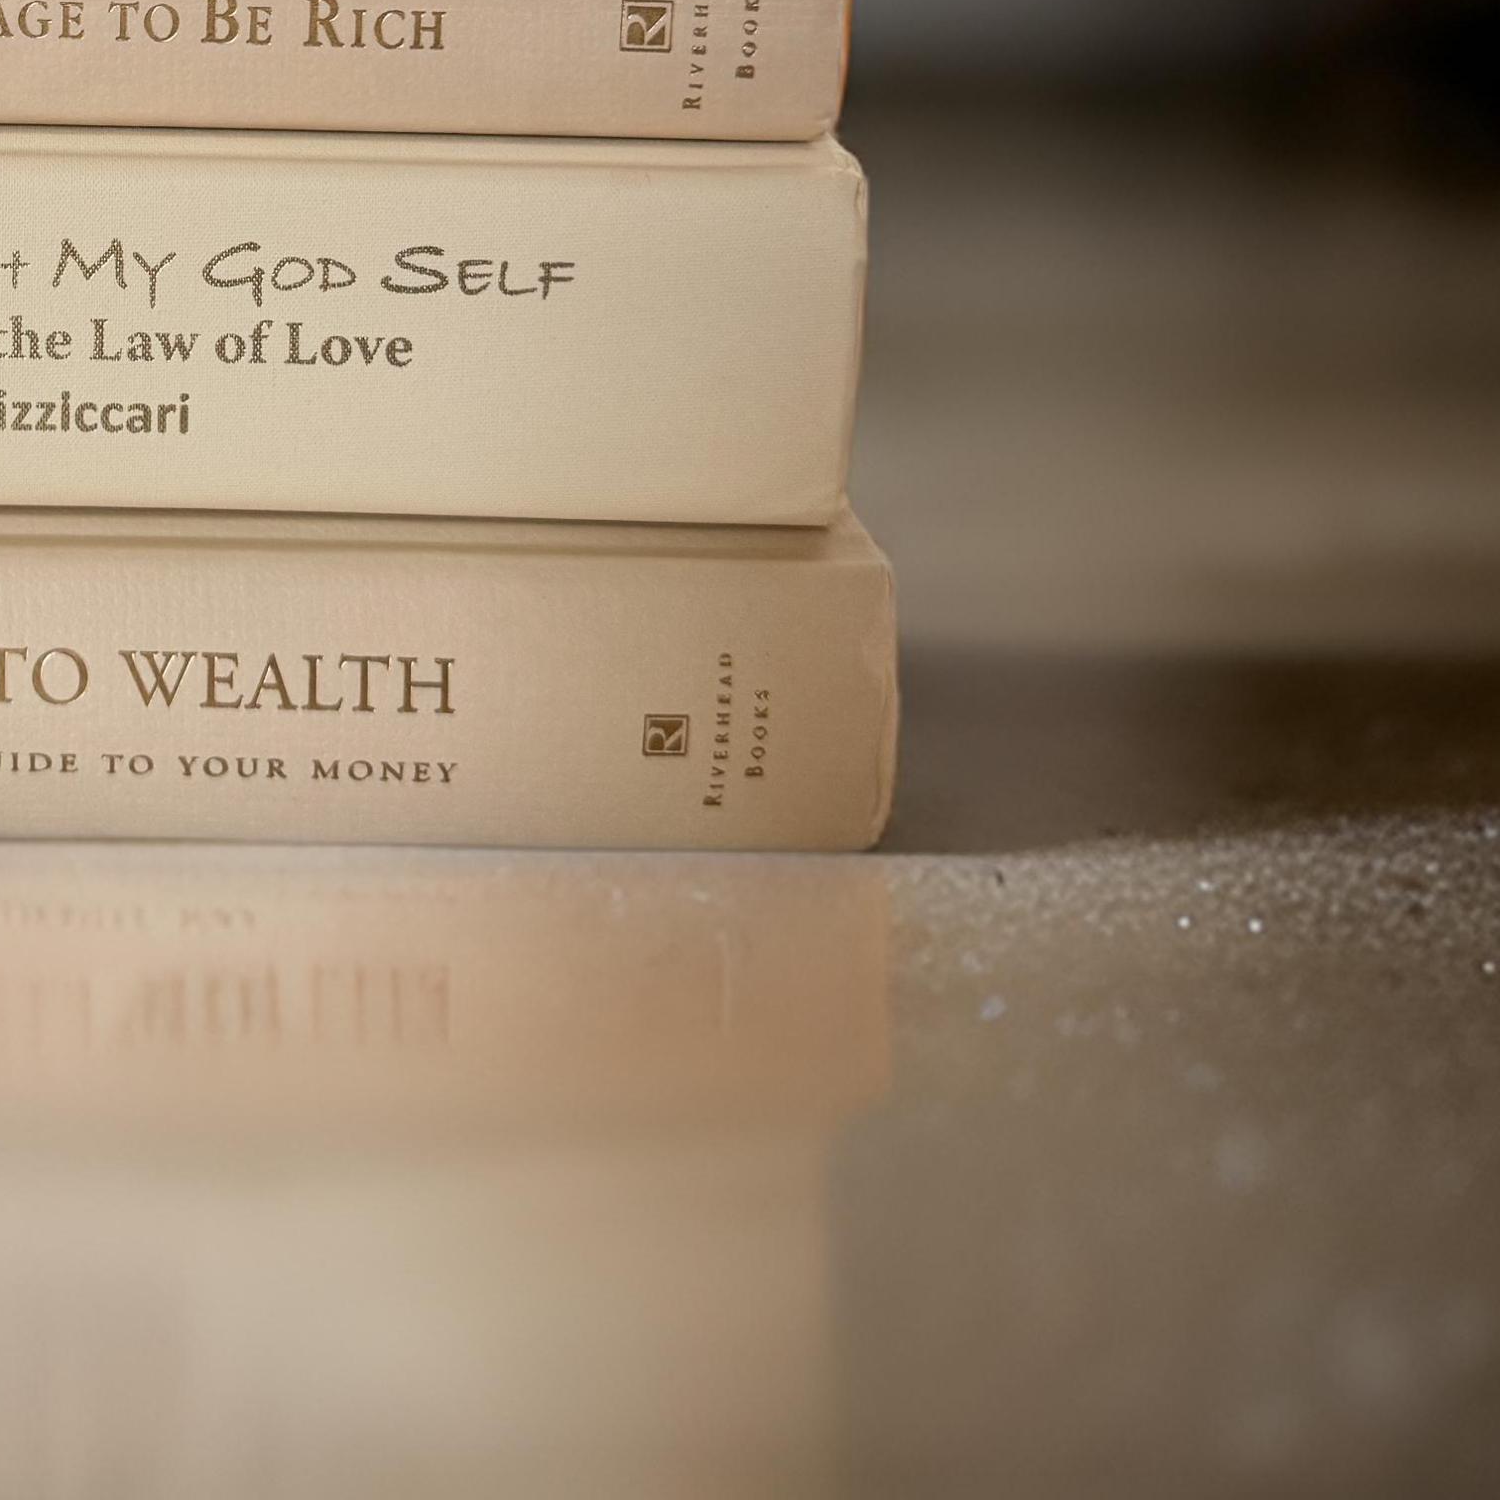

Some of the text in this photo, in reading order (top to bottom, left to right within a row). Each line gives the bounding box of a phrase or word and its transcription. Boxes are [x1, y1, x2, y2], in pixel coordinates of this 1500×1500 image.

[108, 0, 181, 44] TO
[52, 238, 177, 309] MY
[202, 241, 357, 307] GOD
[380, 245, 576, 299] SELF
[89, 318, 200, 363] Law
[214, 319, 274, 365] of
[284, 321, 414, 368] Love
[118, 649, 457, 715] WEALTH
[703, 652, 733, 806] RIVERHEAD
[744, 689, 770, 778] BOOKS
[101, 753, 155, 778] TO
[178, 755, 289, 781] YOUR
[312, 759, 460, 786] MONEY
